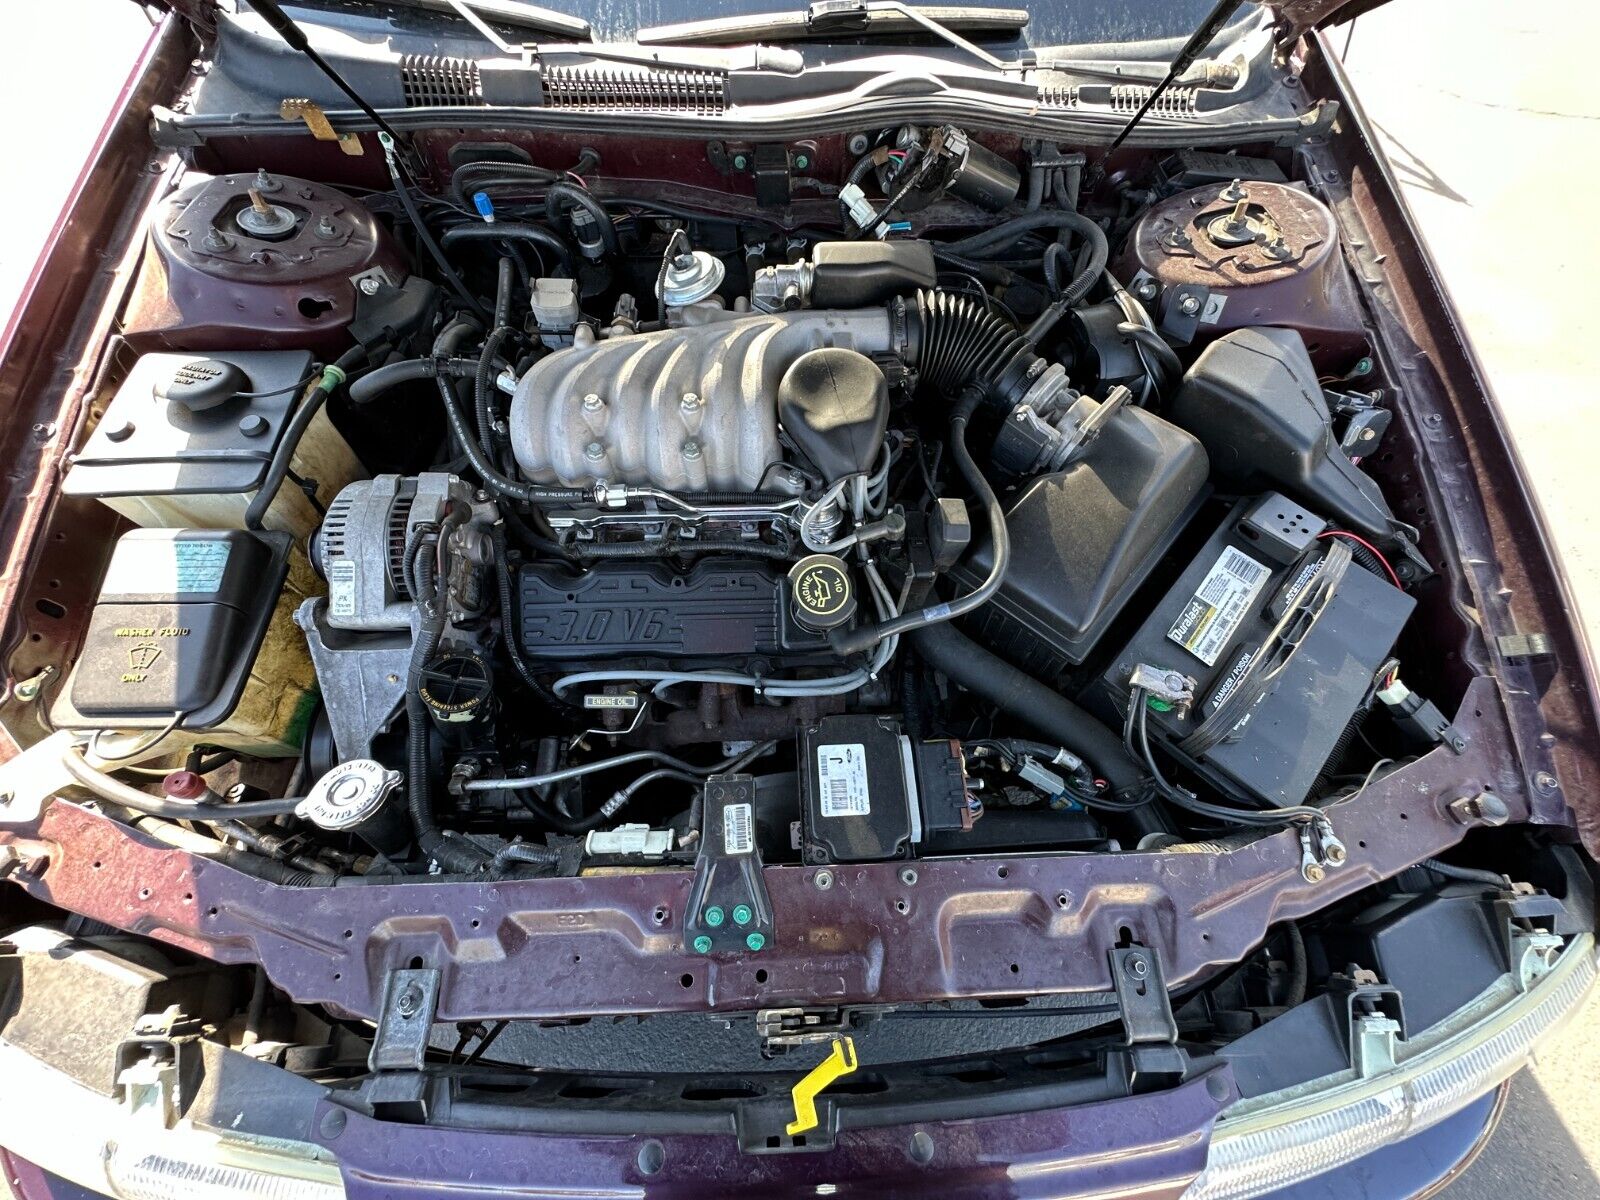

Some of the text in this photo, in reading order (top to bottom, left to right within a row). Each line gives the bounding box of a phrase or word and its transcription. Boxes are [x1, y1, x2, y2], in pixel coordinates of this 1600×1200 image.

[802, 575, 843, 606] ENGINE OIL
[115, 626, 191, 637] WASHER FLUID
[550, 608, 669, 642] 3.0 V6
[1171, 601, 1203, 641] Duralast
[121, 673, 148, 683] ONLY
[1214, 677, 1235, 702] DANGER
[1233, 652, 1251, 675] POISON
[420, 688, 480, 710] POWER STEERING FLUID
[592, 697, 629, 705] ENGINE OIL
